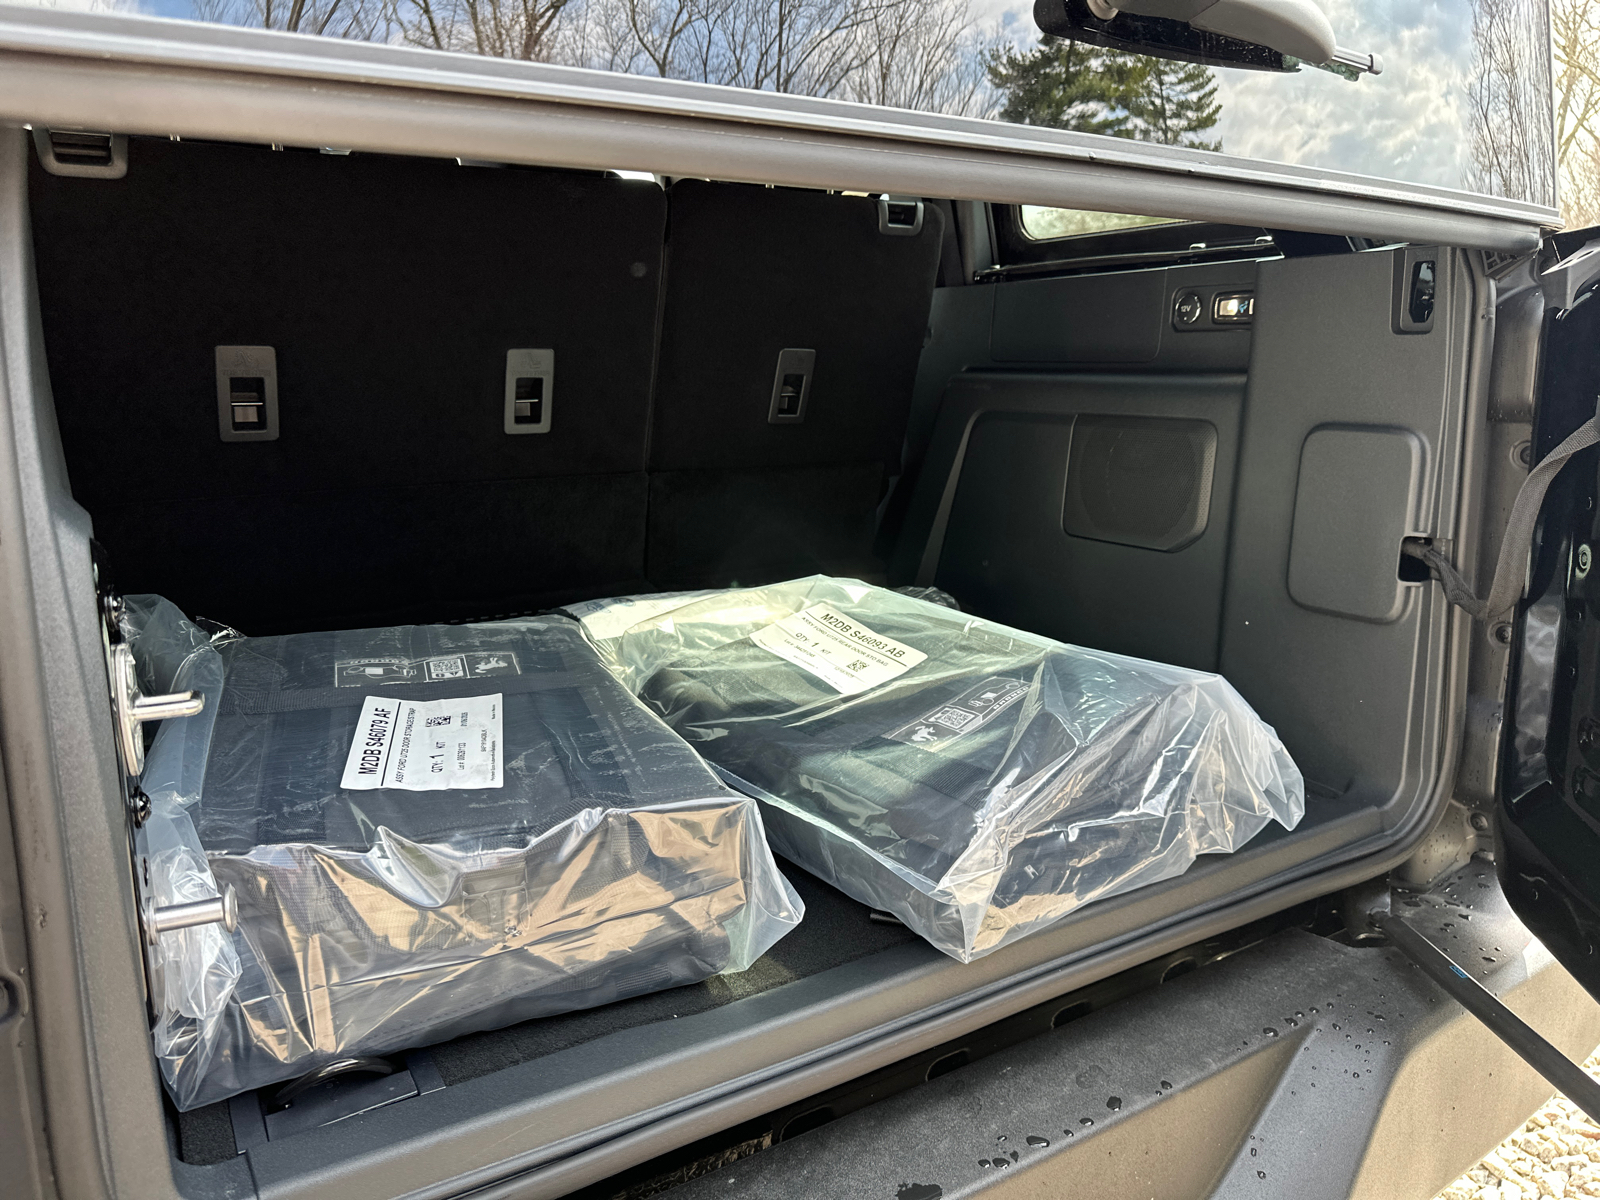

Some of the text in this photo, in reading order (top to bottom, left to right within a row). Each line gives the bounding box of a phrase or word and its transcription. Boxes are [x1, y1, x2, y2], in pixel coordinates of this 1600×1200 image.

[1180, 304, 1192, 313] 12V
[821, 613, 906, 658] M2DB S46093 AB
[837, 639, 853, 649] REAR
[850, 647, 867, 656] DOOR
[358, 707, 391, 775] M2DB S46079 AF
[402, 737, 411, 748] DOOR
[435, 741, 446, 750] KIT
[397, 758, 407, 771] FORD
[431, 760, 444, 774] QTY:
[395, 770, 405, 783] ASSY
